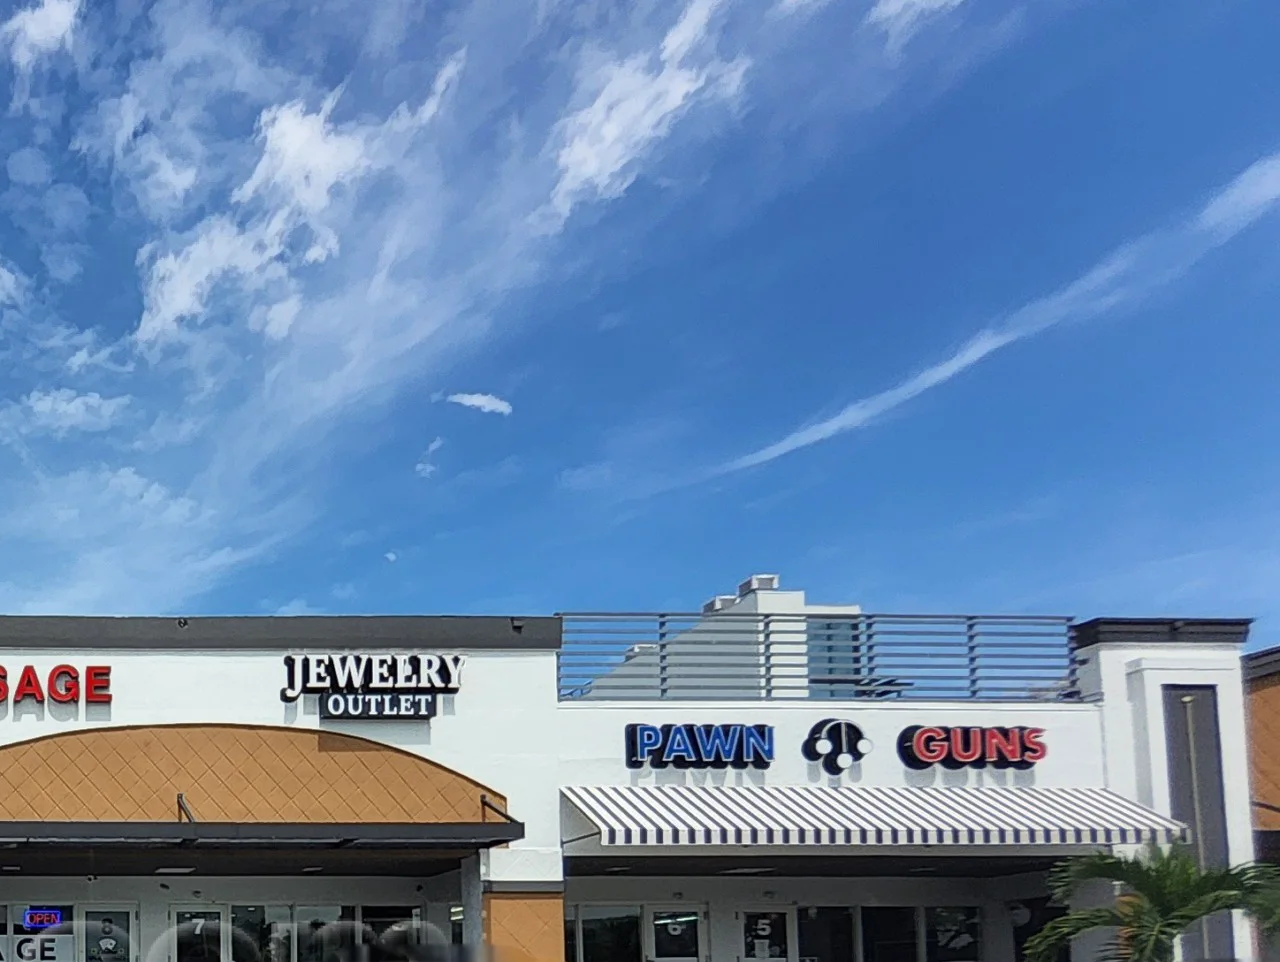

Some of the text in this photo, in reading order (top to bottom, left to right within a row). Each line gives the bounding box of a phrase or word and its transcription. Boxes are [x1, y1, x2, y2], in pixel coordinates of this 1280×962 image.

[284, 655, 467, 697] JEWELRY
[326, 694, 432, 716] OUTLET
[635, 724, 776, 762] PAWN
[911, 726, 1048, 763] GUNS
[27, 911, 61, 924] OPEN
[191, 918, 206, 935] 7
[756, 919, 772, 936] 5
